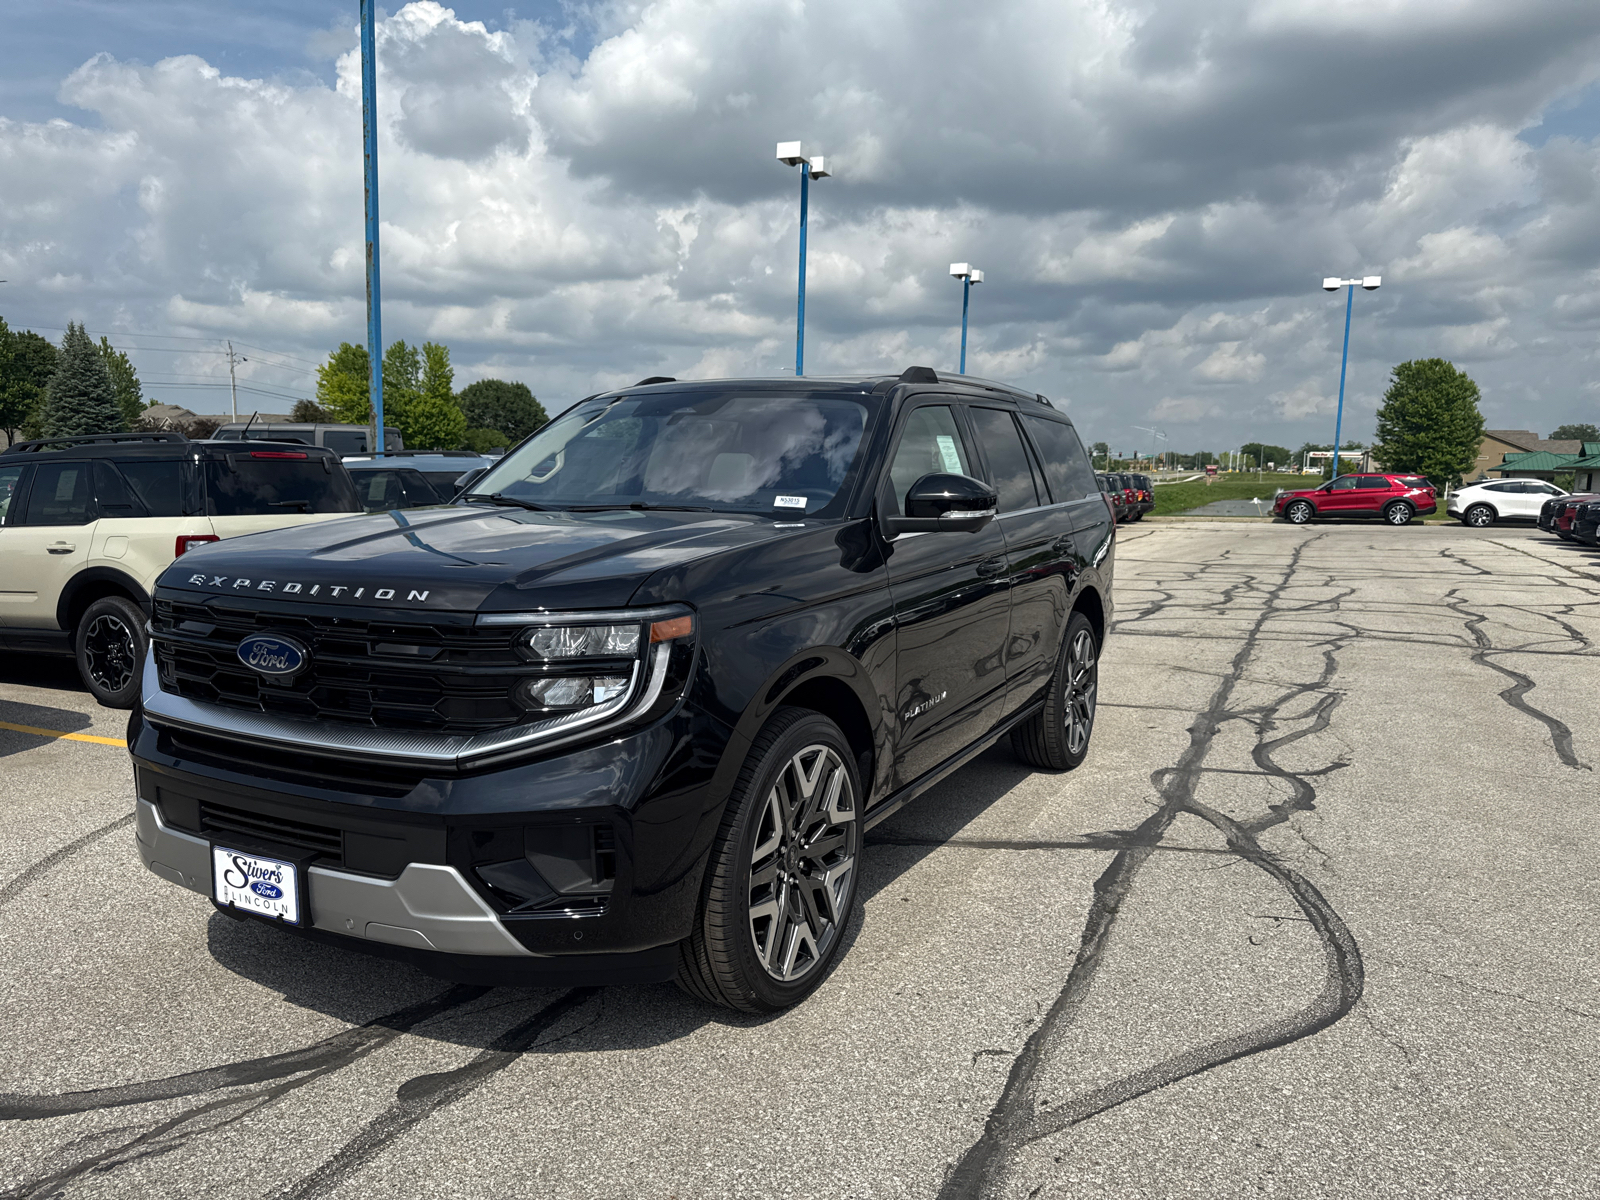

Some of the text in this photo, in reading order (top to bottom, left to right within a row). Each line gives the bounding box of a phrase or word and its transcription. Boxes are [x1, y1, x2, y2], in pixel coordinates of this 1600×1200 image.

[188, 573, 430, 602] EXPEDITION
[249, 641, 289, 669] Ford
[904, 690, 947, 722] PLATINUM
[224, 856, 283, 889] Stivers
[231, 891, 289, 914] LINCOLN
[256, 883, 277, 898] Ford
